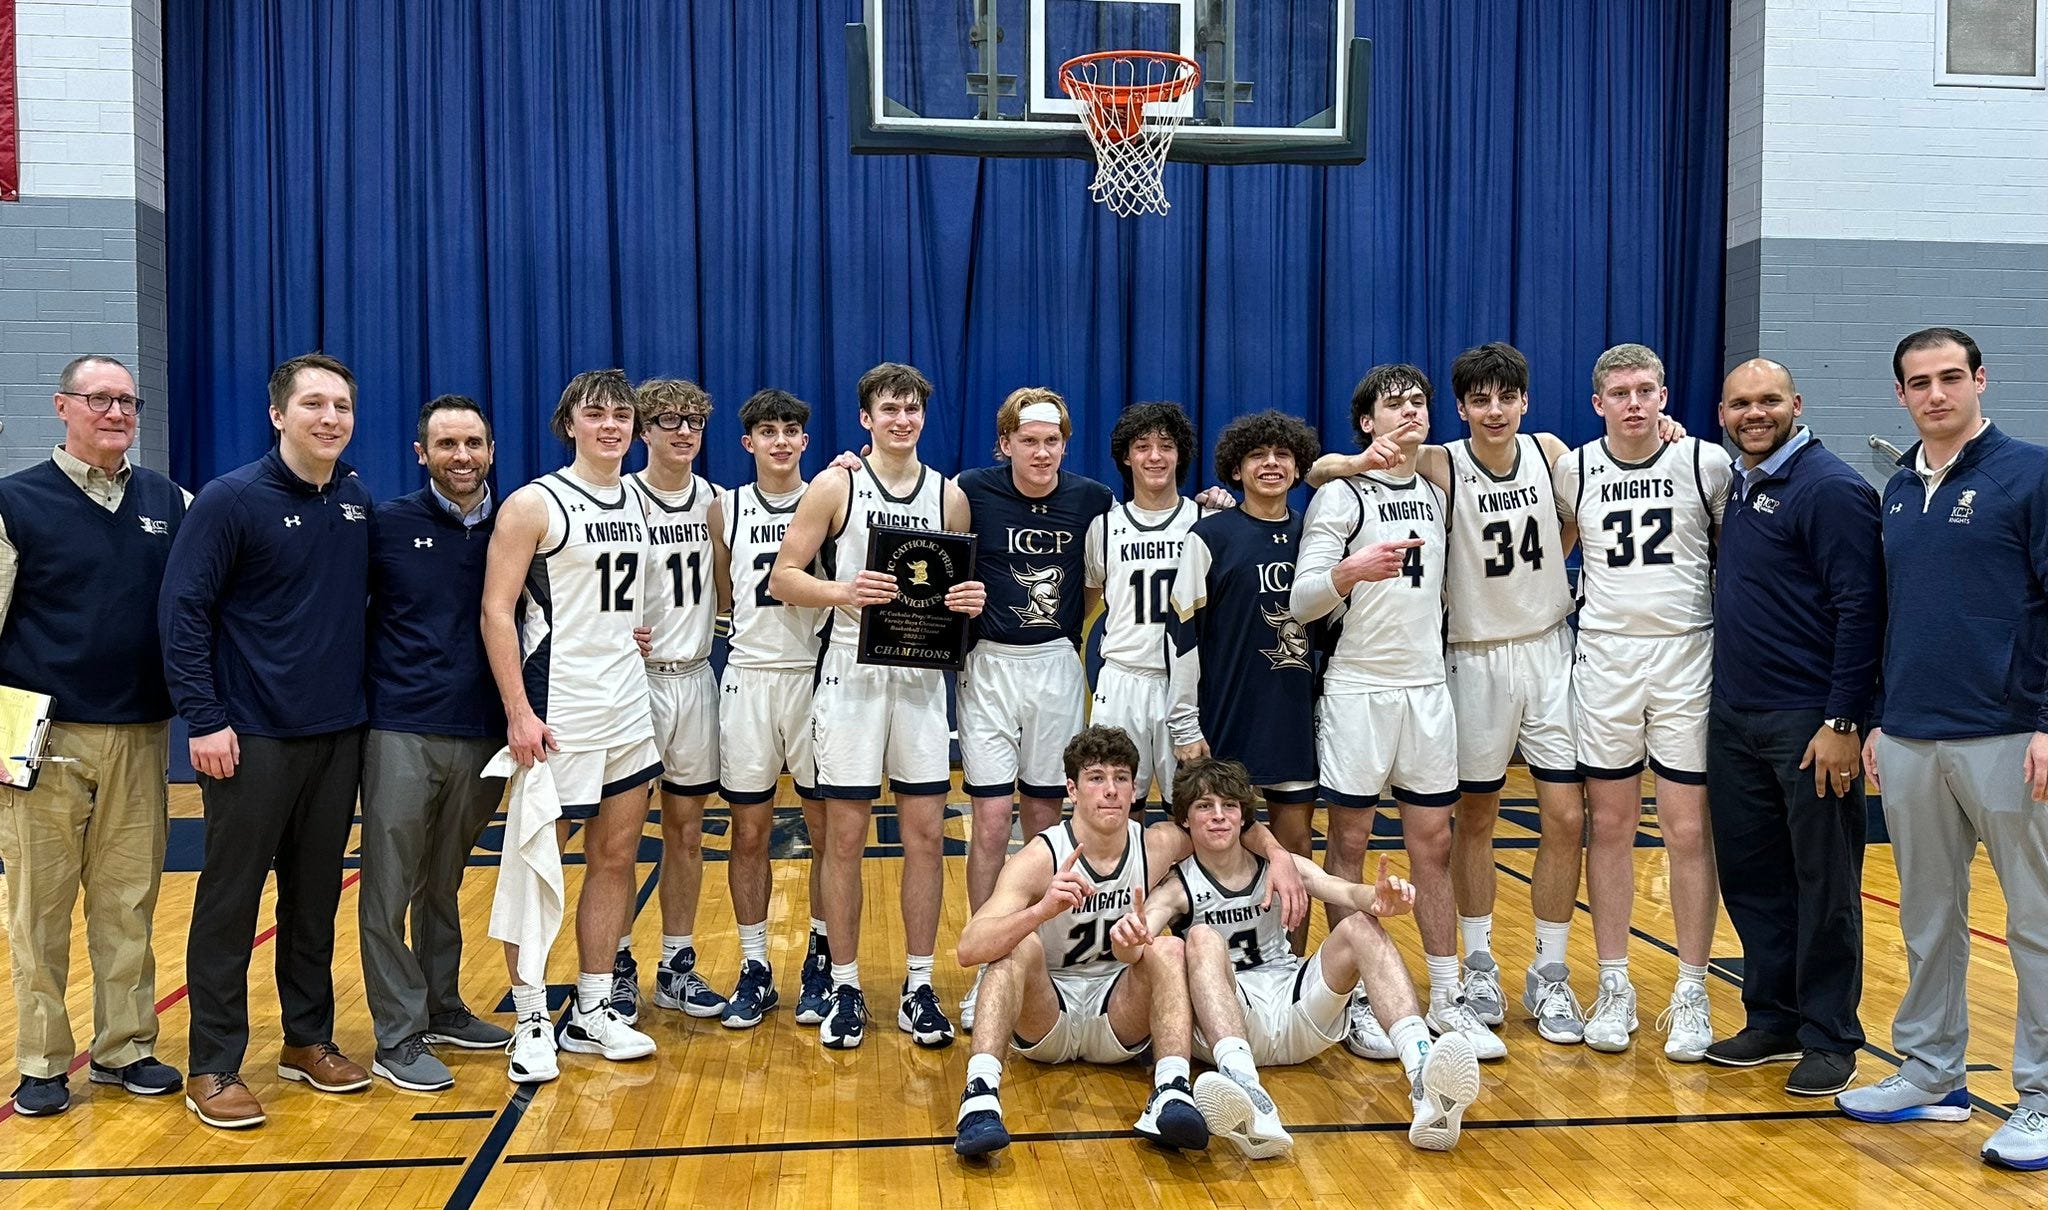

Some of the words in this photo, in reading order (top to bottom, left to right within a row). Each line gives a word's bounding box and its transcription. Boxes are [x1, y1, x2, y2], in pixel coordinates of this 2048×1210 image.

[1478, 485, 1538, 513] KNIGHTS
[1601, 479, 1674, 502] KNIGHTS
[1378, 501, 1434, 522] KNIGHTS
[585, 521, 642, 543] KNIGHTS
[650, 523, 709, 545] KNIGHTS
[750, 524, 791, 543] KNIG
[1006, 527, 1073, 554] ICCP
[1602, 507, 1675, 568] 32
[892, 539, 940, 560] CATHOLIC
[938, 549, 954, 578] PREP
[1120, 541, 1184, 562] KNIGHTS
[1481, 515, 1544, 578] 34
[595, 552, 639, 612] 12
[666, 551, 701, 608] 11
[753, 552, 790, 608] 2
[1256, 562, 1295, 593] ICC
[896, 590, 942, 608] KNIGHTS
[874, 645, 951, 660] CHAMPIONS
[1228, 927, 1265, 972] 3
